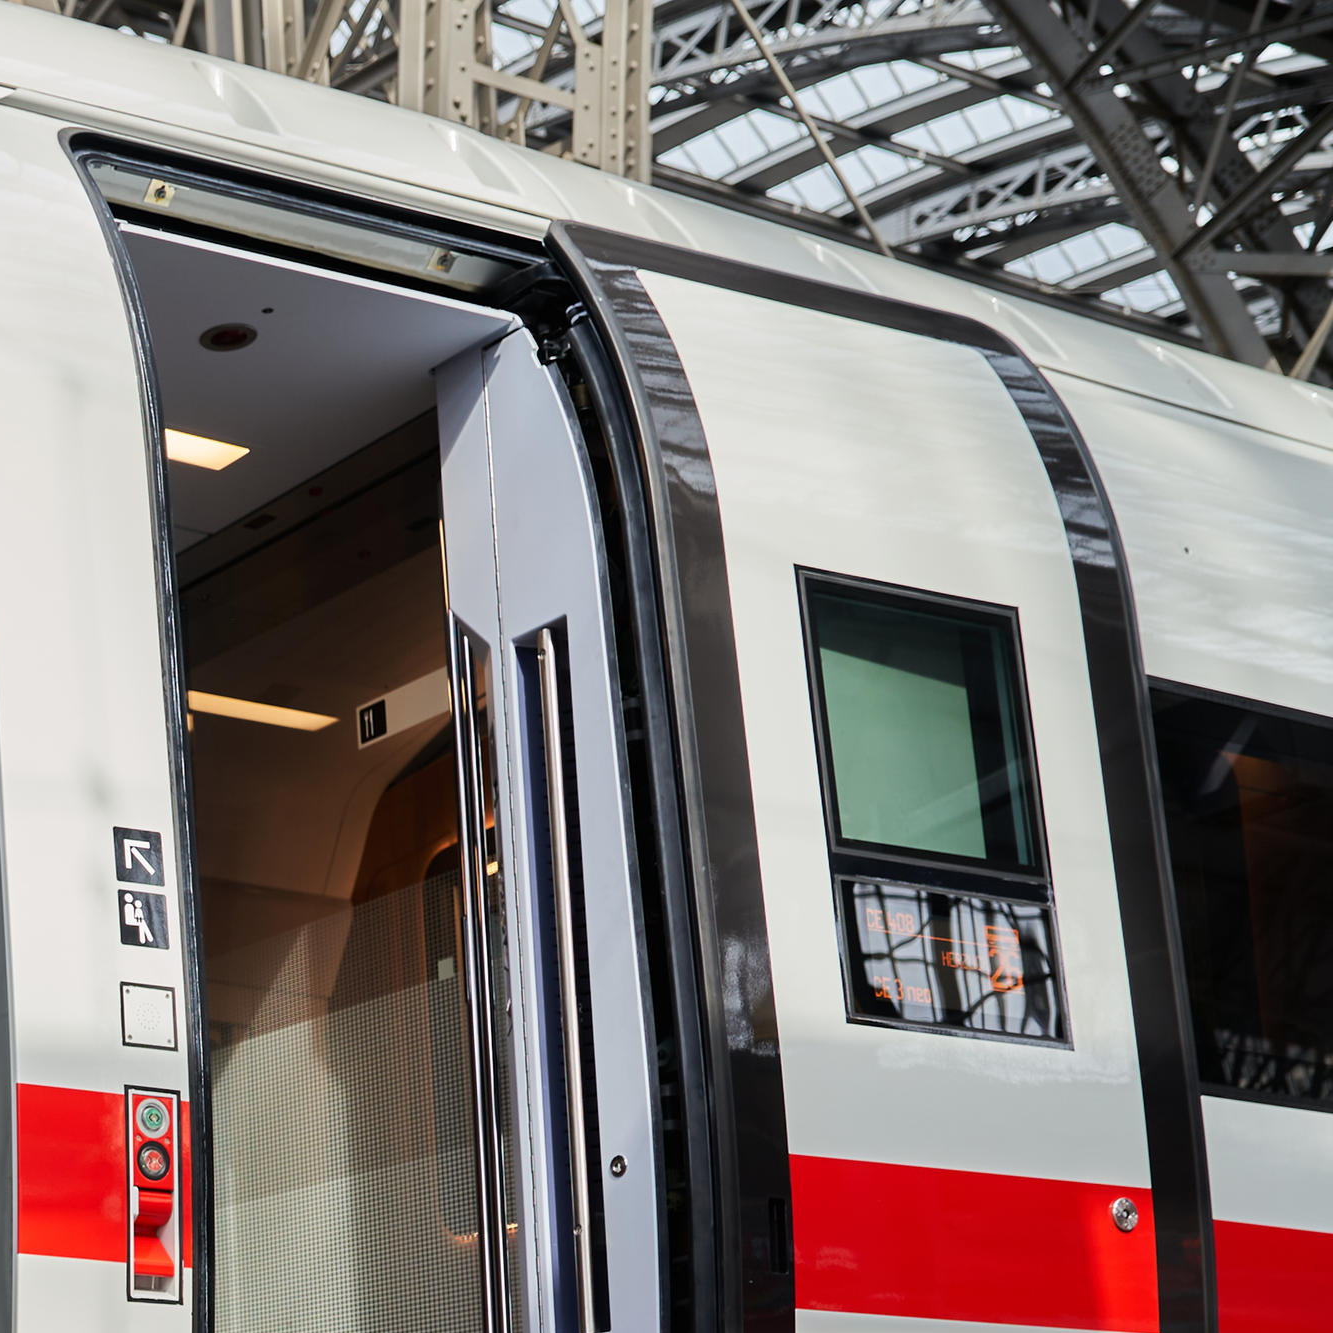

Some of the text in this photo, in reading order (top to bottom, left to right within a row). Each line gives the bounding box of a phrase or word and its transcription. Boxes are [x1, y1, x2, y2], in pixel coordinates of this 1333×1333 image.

[885, 911, 915, 934] 408
[989, 948, 1024, 988] 26
[894, 978, 904, 1000] 3
